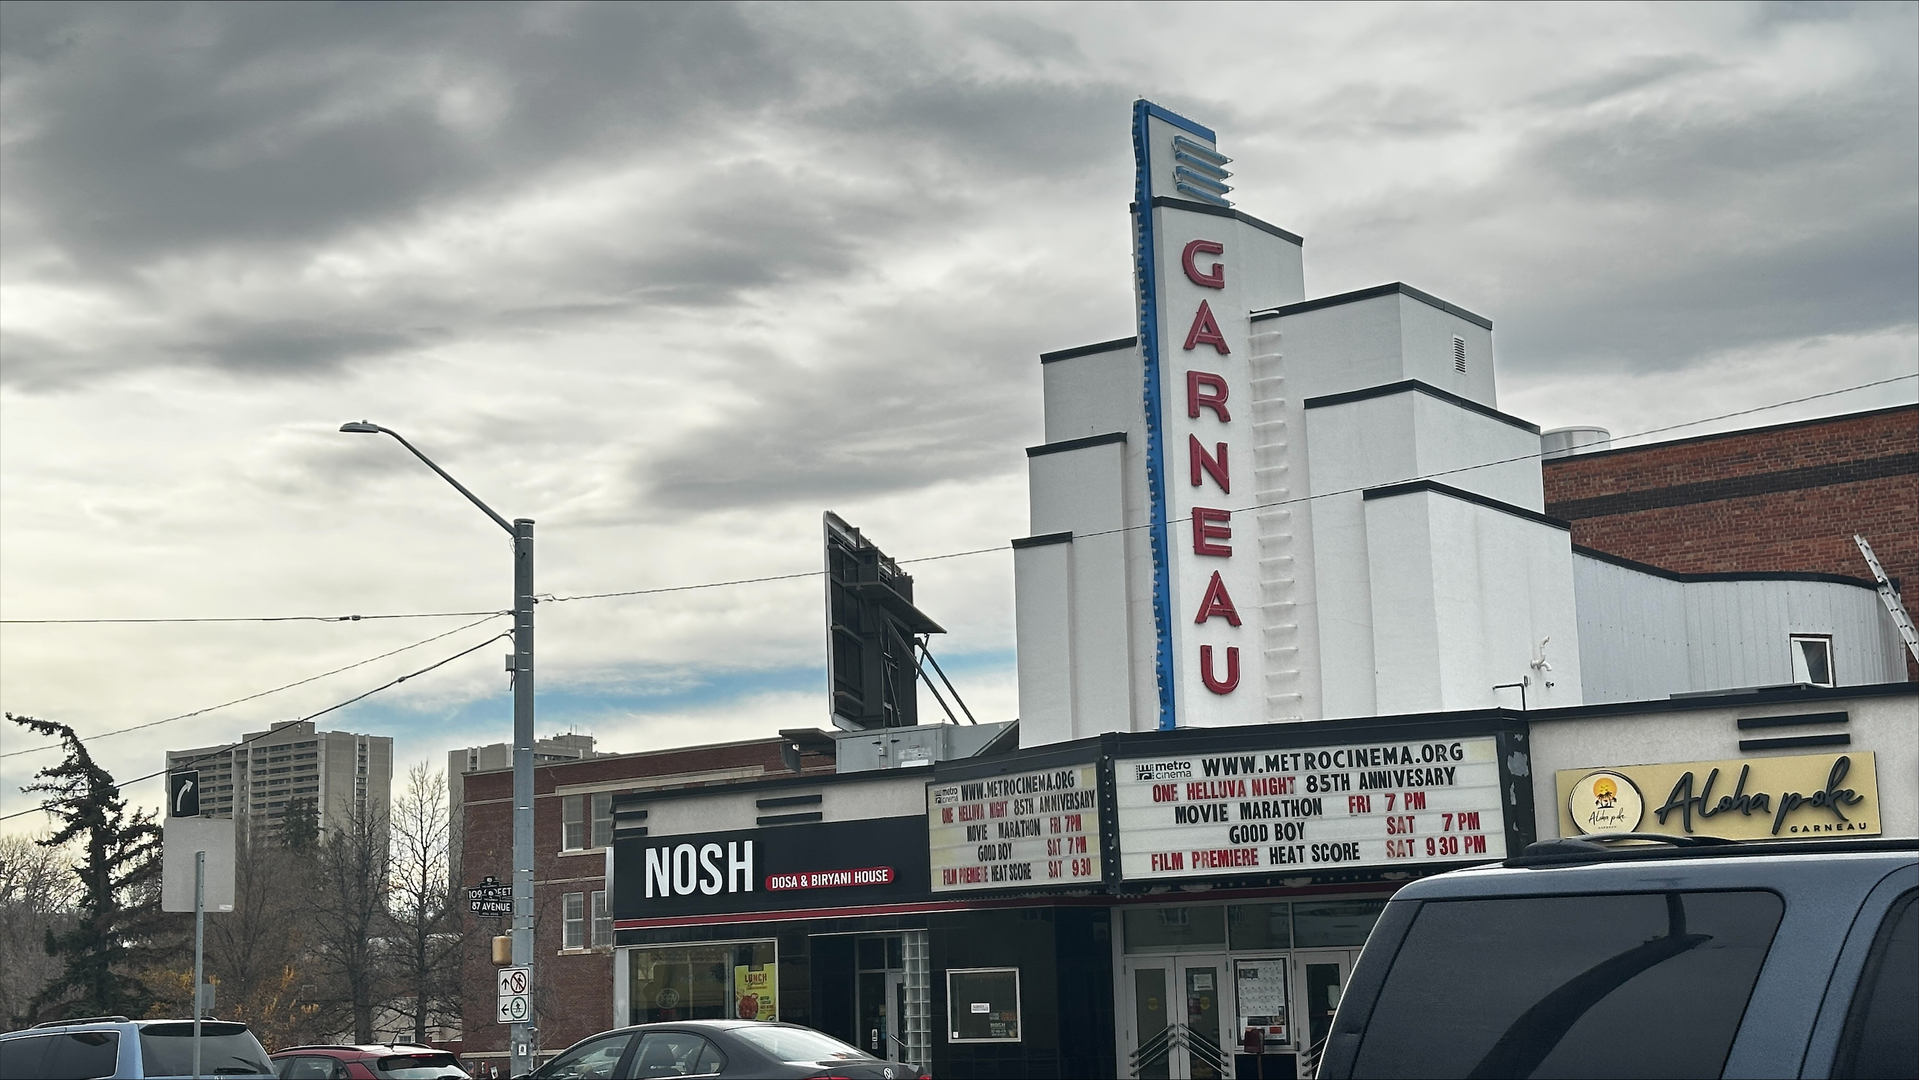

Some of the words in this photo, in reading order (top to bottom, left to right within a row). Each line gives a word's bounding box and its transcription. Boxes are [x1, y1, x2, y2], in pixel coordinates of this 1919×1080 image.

[1181, 239, 1242, 695] GARNEAU
[1155, 760, 1191, 771] metro
[1202, 742, 1464, 777] WWW.METROCINEMA.ORG
[961, 770, 1075, 802] WWW.METROCINEMA.ORG
[1152, 784, 1178, 803] ONE
[1186, 779, 1247, 800] HELLUVA
[1252, 776, 1296, 797] NIGHT
[1306, 773, 1351, 794] 85TH
[1359, 766, 1456, 790] ANNIVESARY
[1155, 770, 1192, 780] cinema
[1175, 803, 1228, 825] MOVIE
[1240, 797, 1323, 821] MARATHON
[1348, 795, 1371, 814] FRI
[1384, 793, 1396, 812] 7
[1404, 792, 1427, 811] PM
[1654, 764, 1771, 834] Aloha
[1771, 755, 1865, 836] poke
[942, 807, 954, 824] ONE
[958, 803, 985, 823] HELLUVA
[989, 800, 1008, 819] NIGHT
[1014, 797, 1034, 816] 85TH
[966, 824, 988, 842] MOVIE
[998, 818, 1041, 839] MARATHON
[1050, 816, 1061, 834] FRI
[1229, 823, 1269, 845] GOOD
[1274, 821, 1305, 842] BOY
[1386, 816, 1415, 835] SAT
[1442, 813, 1453, 832] 7
[1458, 811, 1481, 831] PM
[1790, 822, 1868, 834] GARNEAU
[977, 844, 996, 862] GOOD
[998, 842, 1012, 860] BOY
[1047, 838, 1062, 856] SAT
[1151, 852, 1184, 872] FILM
[1192, 848, 1259, 869] PREMIERE
[1269, 844, 1305, 865] HEAT
[1311, 841, 1360, 862] SCORE
[1386, 839, 1415, 858] SAT
[1464, 834, 1487, 854] PM
[645, 840, 754, 899] NOSH
[771, 874, 798, 890] DOSA
[800, 874, 808, 888] &
[811, 871, 852, 887] BIRYANI
[854, 869, 889, 884] HOUSE
[943, 868, 957, 885] FILM
[990, 864, 1008, 882] HEAT
[1008, 862, 1032, 881] SCORE
[1048, 860, 1062, 879] SAT
[468, 889, 482, 899] 109
[471, 901, 481, 911] 87
[482, 902, 511, 912] AVENUE
[744, 973, 767, 983] LUNCH
